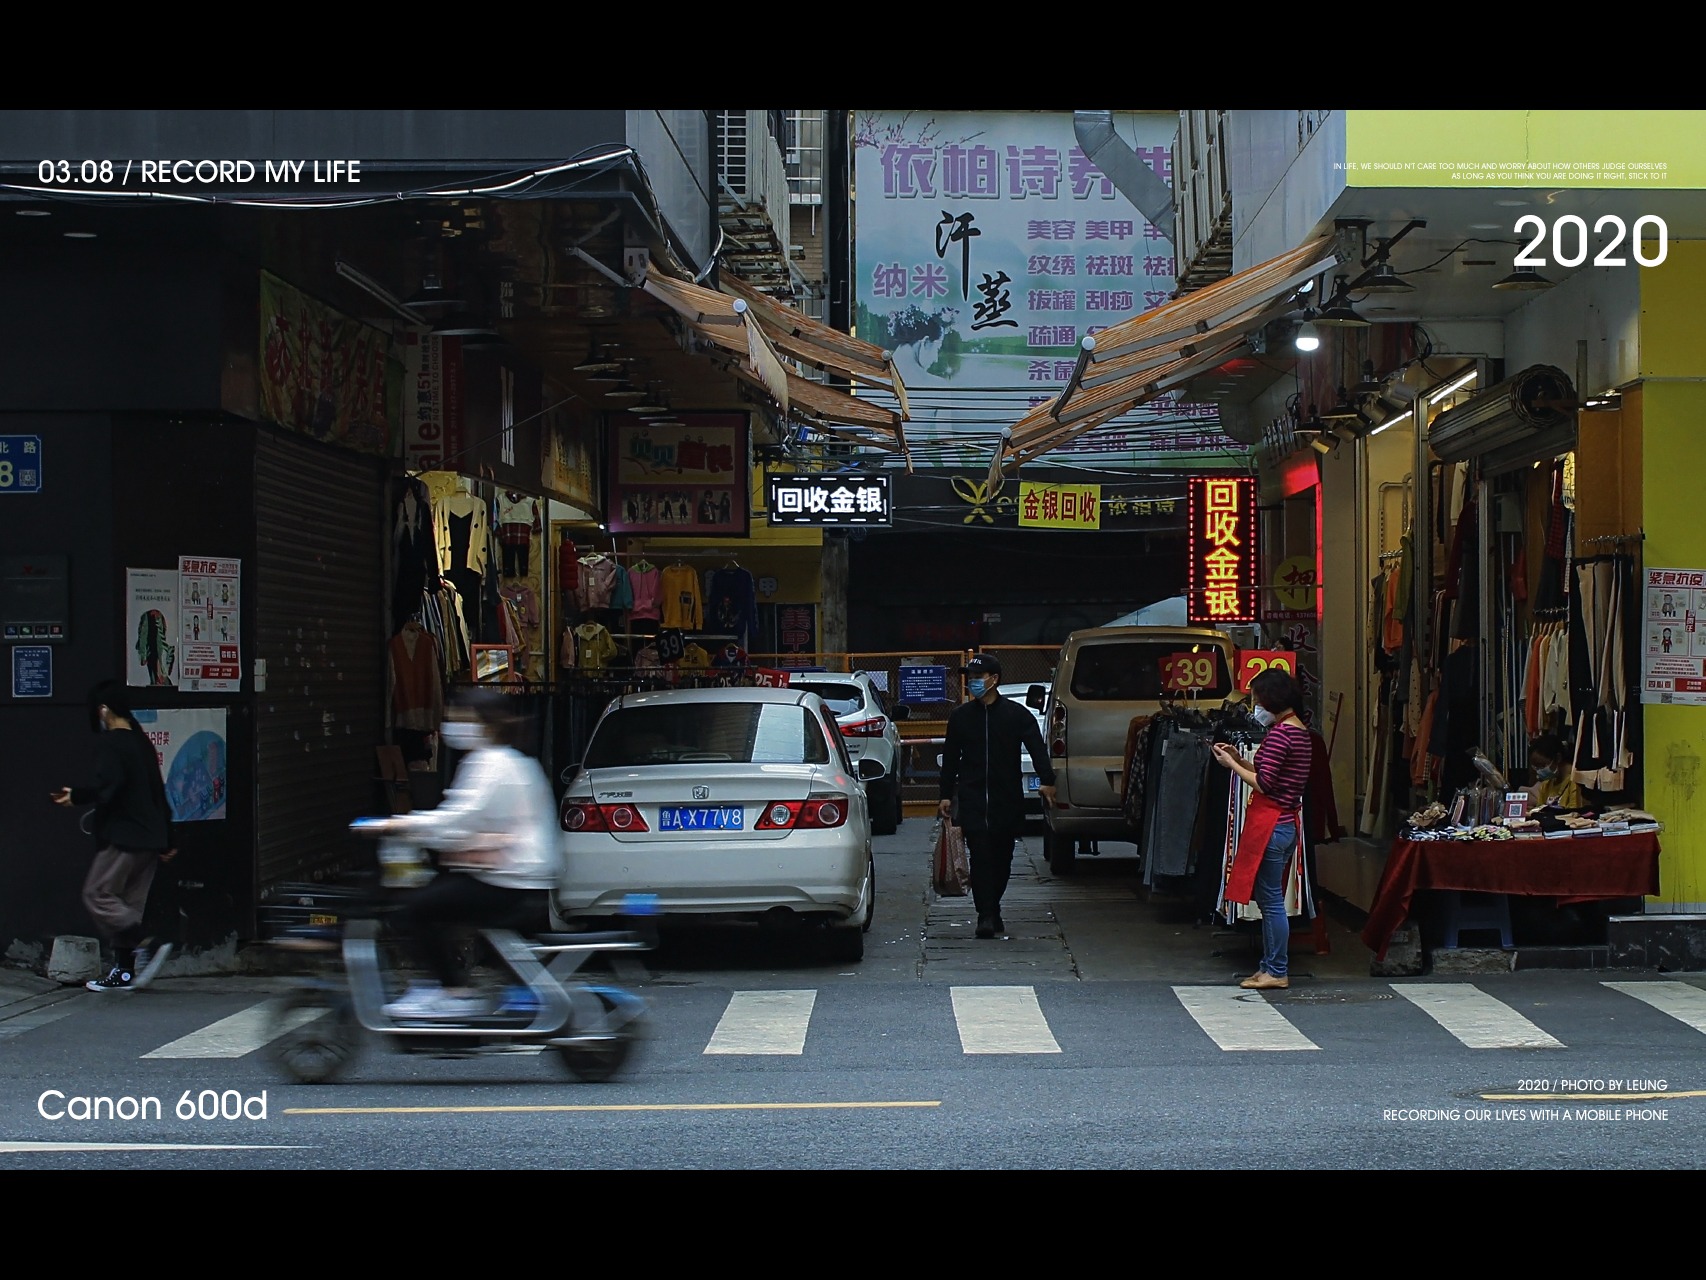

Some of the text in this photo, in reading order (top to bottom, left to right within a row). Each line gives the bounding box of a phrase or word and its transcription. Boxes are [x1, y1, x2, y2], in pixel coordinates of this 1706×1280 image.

[1027, 220, 1076, 240] 美容
[1085, 220, 1134, 240] 美甲
[1027, 255, 1076, 276] 纹绣
[1085, 255, 1134, 276] 祛斑
[872, 263, 949, 299] 纳米
[1027, 290, 1076, 311] 拔罐
[1085, 290, 1134, 311] 刮痧
[1028, 325, 1076, 345] 疏通
[1028, 360, 1076, 381] 杀菌
[777, 486, 882, 513] 回收金银
[1023, 489, 1097, 522] 金银回收
[1205, 481, 1241, 615] 回收金银
[758, 577, 778, 598] 甲
[1650, 571, 1704, 587] 紧急抗疫
[659, 635, 680, 659] 39
[1176, 658, 1213, 687] 39
